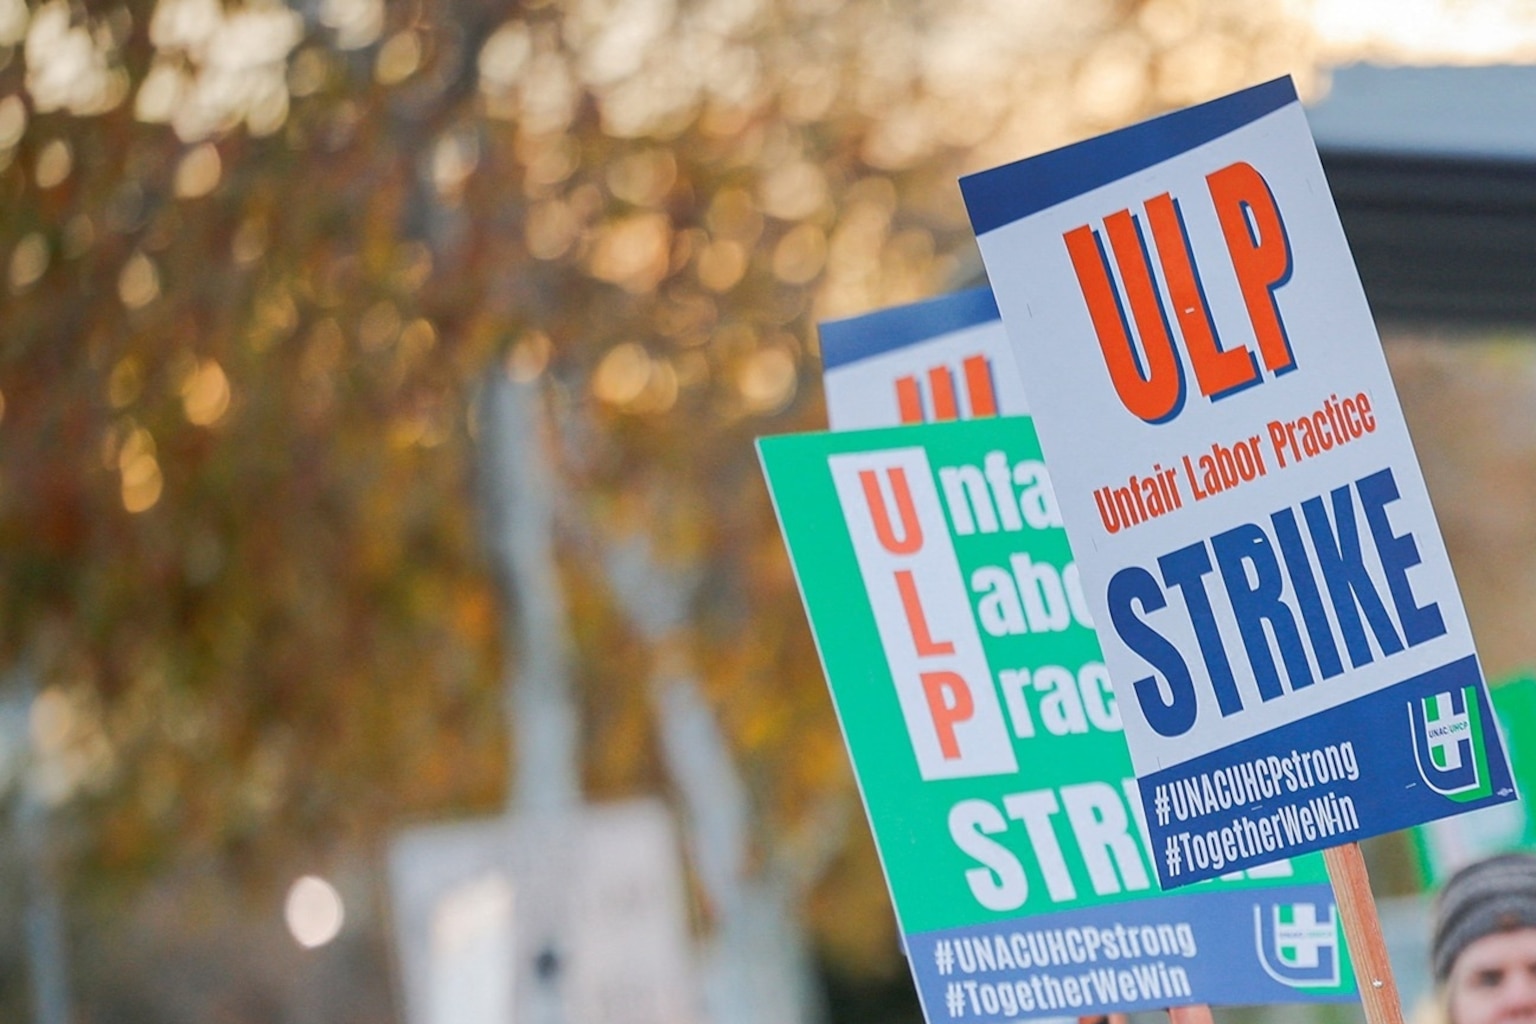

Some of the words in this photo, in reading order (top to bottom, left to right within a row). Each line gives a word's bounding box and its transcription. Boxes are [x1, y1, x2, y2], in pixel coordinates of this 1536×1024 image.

[1062, 160, 1298, 425] ULP
[1093, 464, 1183, 534] Unfair
[1182, 434, 1267, 501] Labor
[1267, 392, 1376, 469] Practice
[1106, 467, 1447, 738] STRIKE
[1154, 740, 1360, 827] #UNACUHCPstrong
[1165, 792, 1360, 878] #TogetherWeWin
[934, 921, 1197, 976] #UNACUHCPstrong
[945, 961, 1192, 1018] #TogetherWeWin
